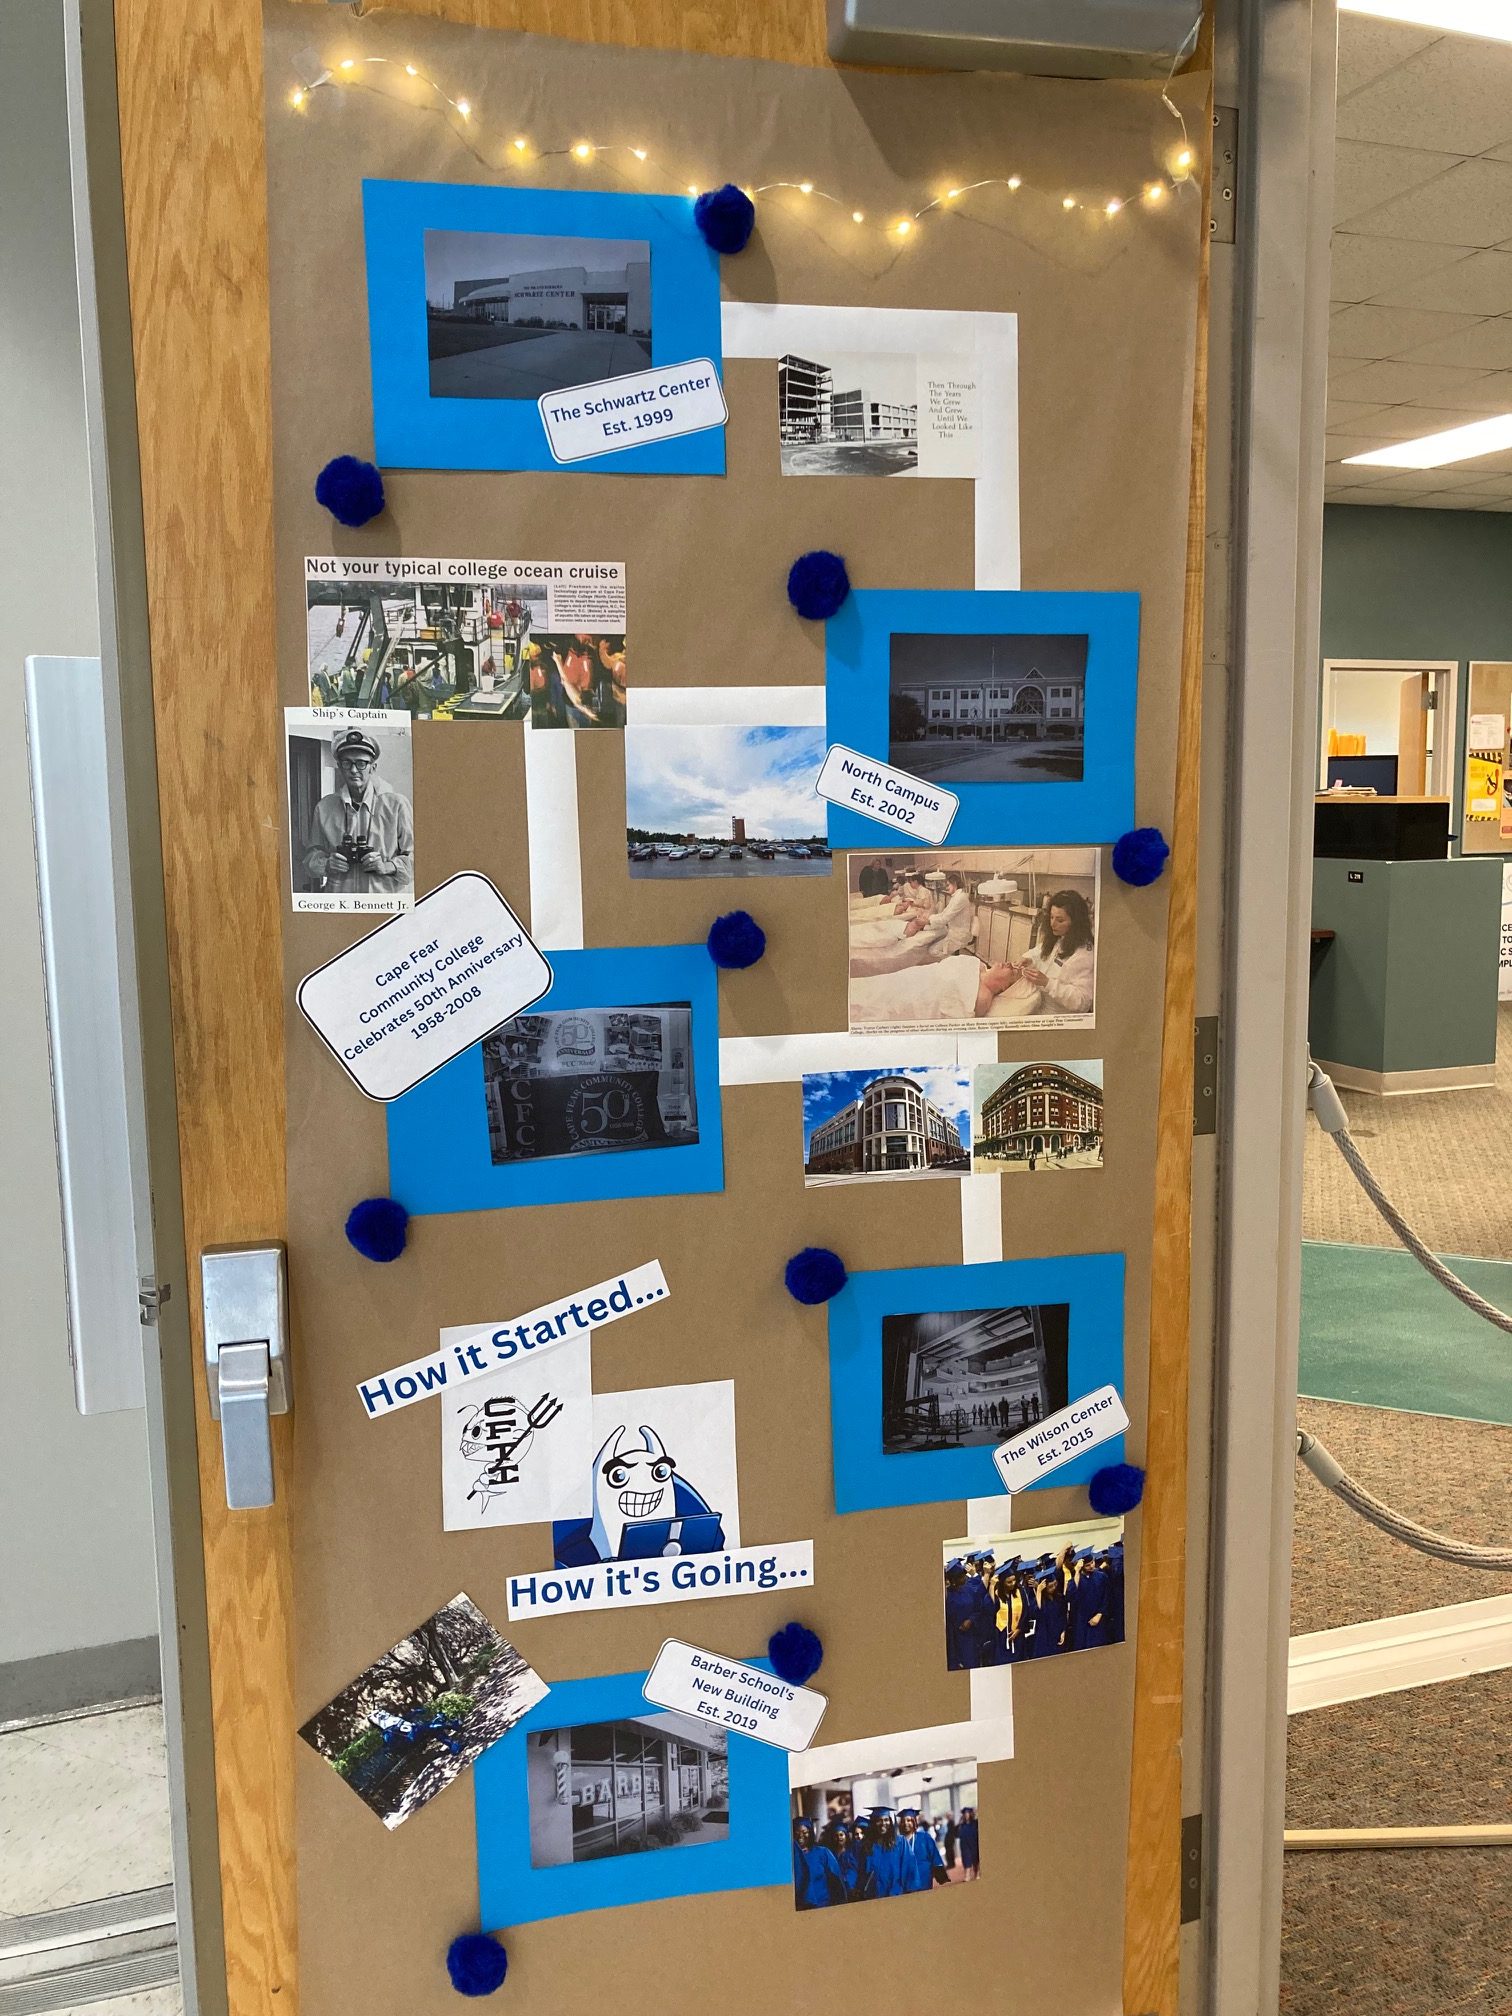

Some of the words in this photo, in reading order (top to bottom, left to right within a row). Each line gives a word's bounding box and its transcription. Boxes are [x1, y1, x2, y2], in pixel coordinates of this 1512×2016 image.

[550, 407, 581, 423] The
[584, 389, 656, 416] Schwartz
[658, 376, 711, 398] Center
[928, 381, 944, 389] Then
[947, 381, 976, 390] Through
[602, 420, 632, 437] Est.
[634, 408, 674, 429] 1999
[307, 559, 337, 573] Not
[342, 562, 379, 576] your
[385, 561, 441, 577] typical
[448, 562, 508, 579] college
[514, 566, 563, 578] ocean
[569, 565, 618, 579] cruise
[312, 708, 344, 720] Ship's
[348, 709, 388, 720] Captain
[841, 760, 882, 787] North
[885, 779, 940, 811] Campus
[850, 788, 875, 808] Est.
[878, 800, 915, 824] 2002
[298, 900, 336, 910] George
[339, 900, 350, 909] K.
[354, 901, 394, 910] Bennett
[397, 901, 409, 910] Jr.
[359, 968, 435, 1024] Community
[434, 934, 484, 973] College
[375, 960, 411, 987] Cape
[410, 938, 440, 964] Fear
[344, 1009, 415, 1061] Celebrates
[413, 986, 447, 1012] 50th
[449, 933, 525, 989] Anniversary
[411, 985, 482, 1040] 1958-2008
[566, 1089, 582, 1113] FEAR
[580, 1075, 634, 1092] COMMUNITY
[566, 1116, 579, 1140] CAPE
[632, 1091, 645, 1133] COLLEGE
[360, 1361, 447, 1412] How
[453, 1344, 488, 1376] it
[491, 1279, 664, 1360] Started...
[484, 1396, 520, 1486] CFTI
[1001, 1444, 1026, 1466] The
[1025, 1420, 1070, 1450] Wilson
[1070, 1395, 1114, 1424] Center
[1037, 1447, 1062, 1467] Est.
[1062, 1427, 1094, 1452] 2015
[510, 1576, 594, 1608] How
[606, 1566, 660, 1598] it's
[671, 1555, 808, 1589] Going...
[691, 1655, 737, 1680] Barber
[738, 1672, 795, 1701] School's
[692, 1678, 723, 1697] New
[725, 1689, 780, 1720] Building
[696, 1702, 721, 1718] Est.
[723, 1710, 758, 1730] 2019
[581, 1773, 661, 1804] BARBER
